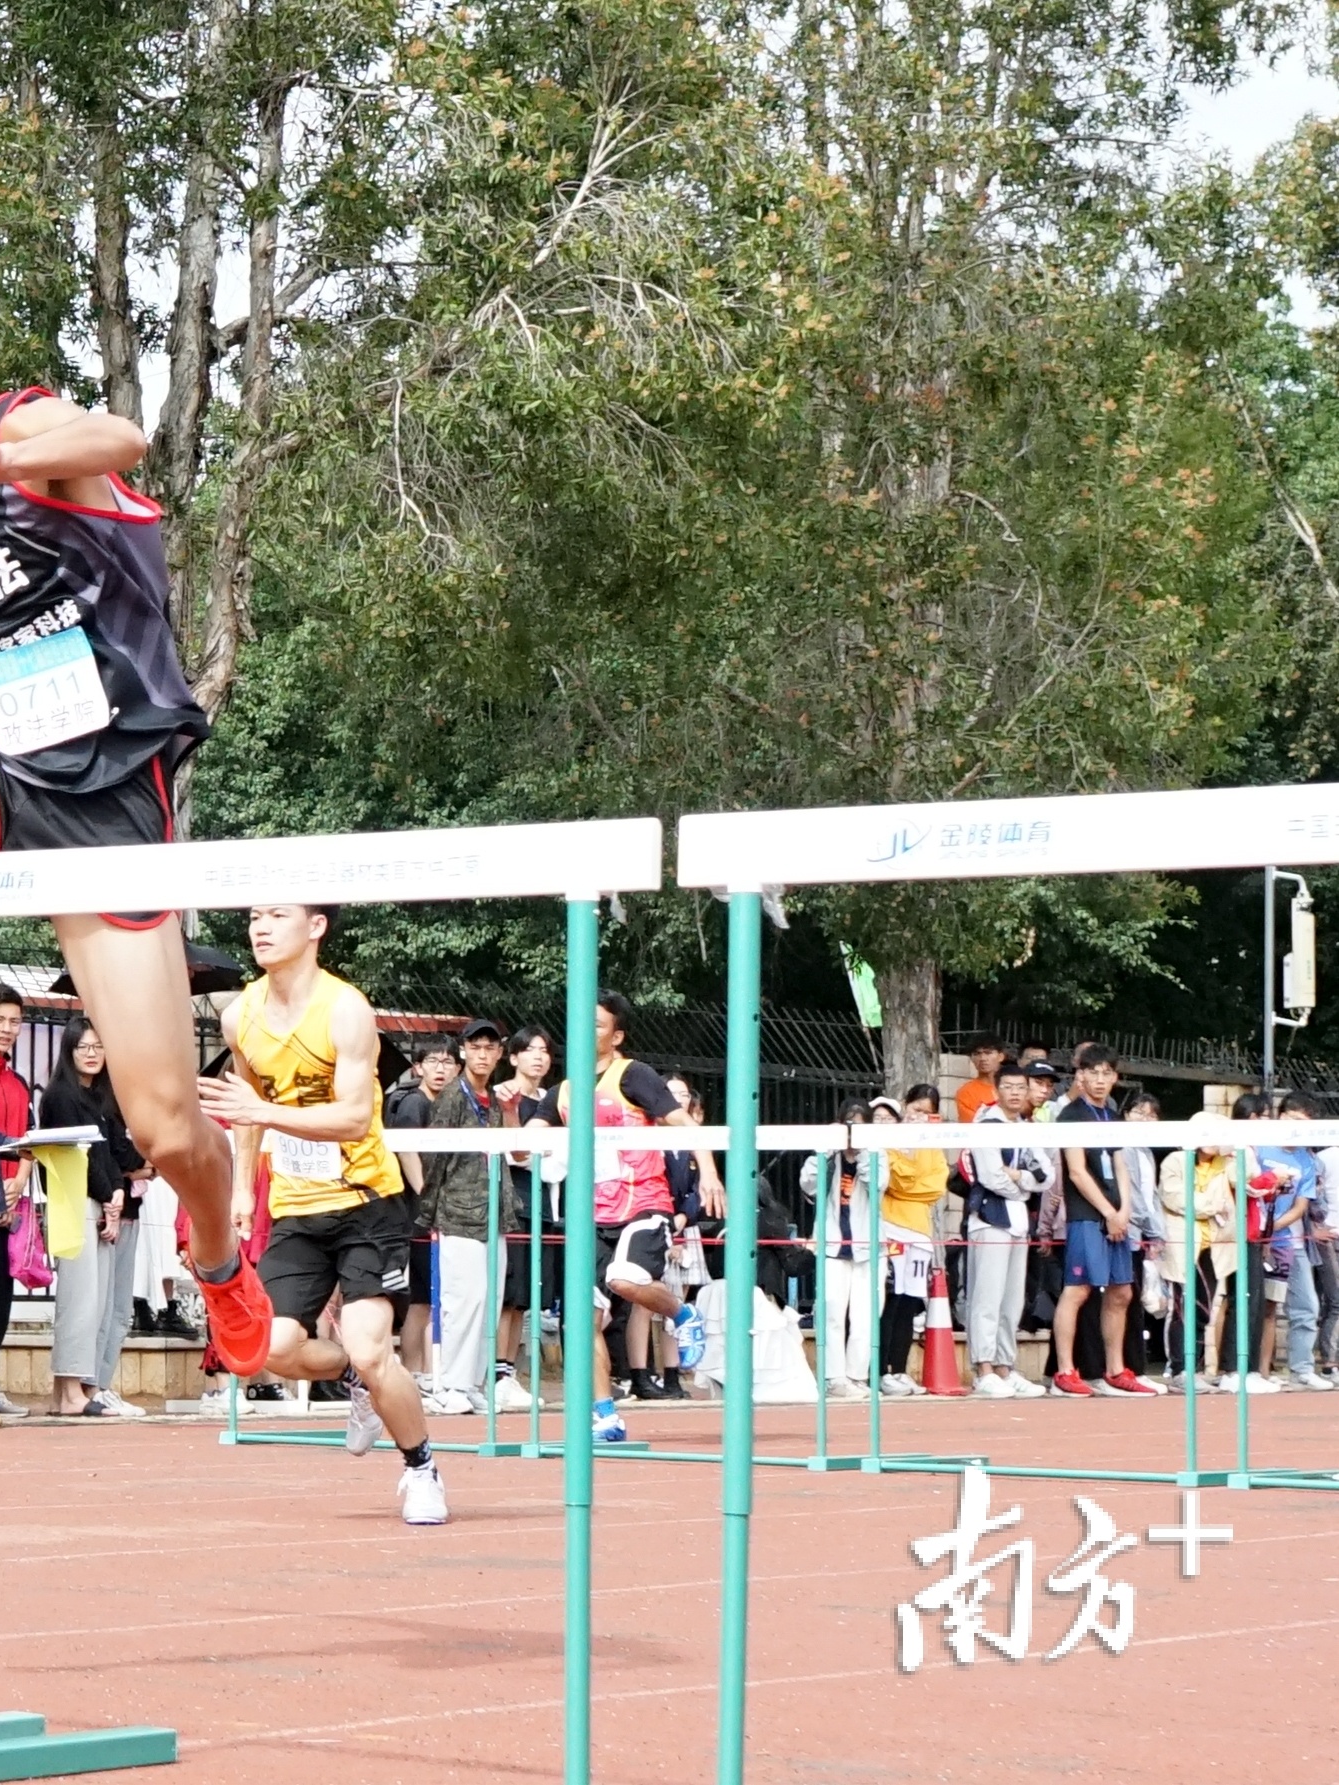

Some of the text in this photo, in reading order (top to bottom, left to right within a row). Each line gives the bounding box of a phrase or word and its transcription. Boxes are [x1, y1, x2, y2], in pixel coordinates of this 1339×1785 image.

[0, 670, 81, 718] 0711
[1, 699, 96, 747] 政法学院
[939, 820, 1051, 848] 金陵体育
[1287, 813, 1339, 840] 中国
[278, 1135, 329, 1157] 9005
